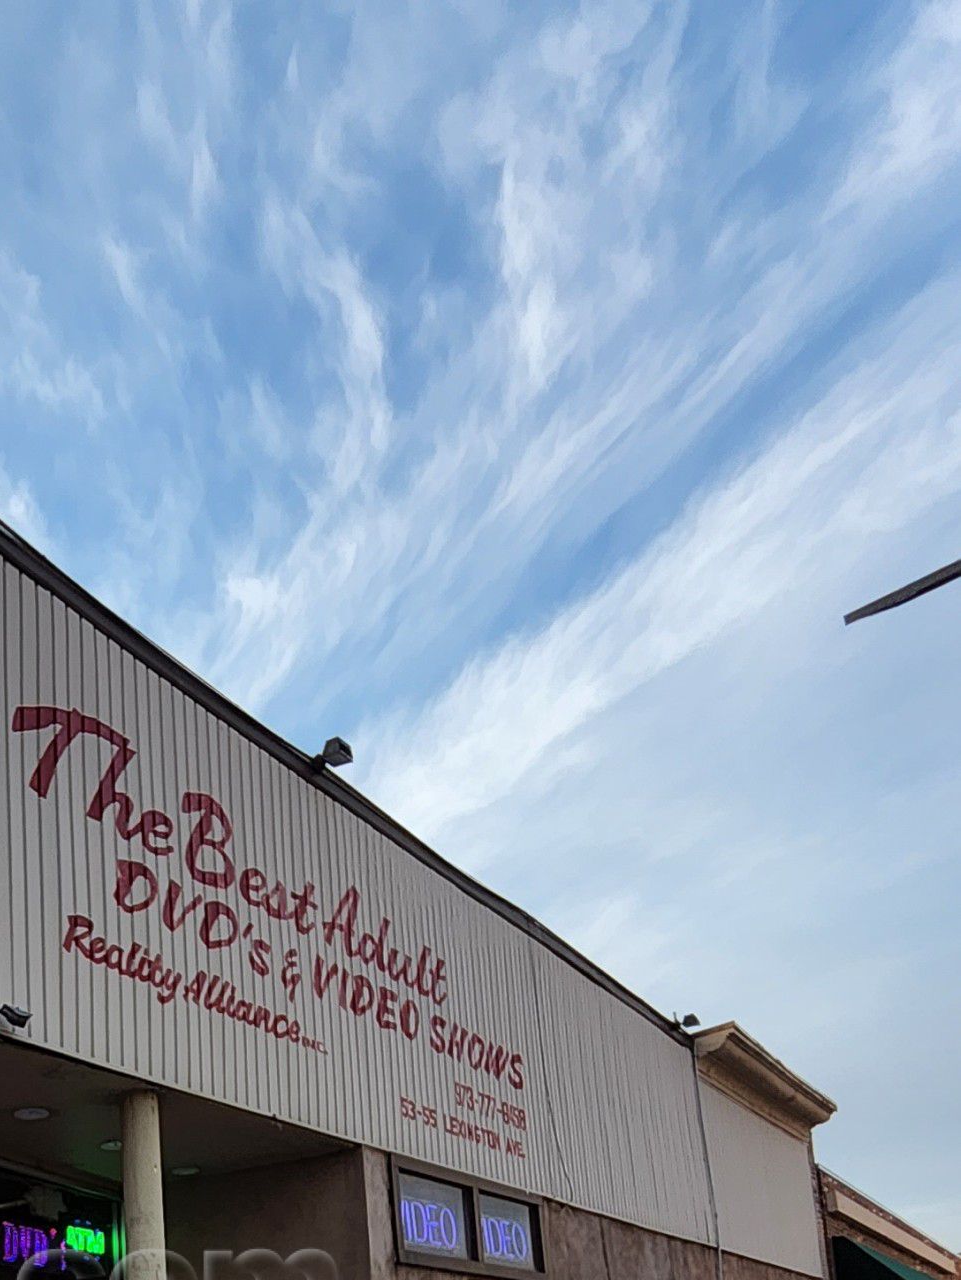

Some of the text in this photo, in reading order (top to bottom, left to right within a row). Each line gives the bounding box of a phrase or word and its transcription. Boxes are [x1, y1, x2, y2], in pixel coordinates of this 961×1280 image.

[12, 706, 447, 1008] The Best Adult
[63, 914, 182, 1005] Reality
[183, 970, 301, 1043] Alliance
[281, 949, 301, 1003] &
[313, 953, 420, 1041] VIDEO
[430, 1014, 524, 1091] SHOWS
[400, 1095, 438, 1130] 53-55
[66, 1224, 105, 1256] ATM
[479, 1216, 529, 1261] IDEO
